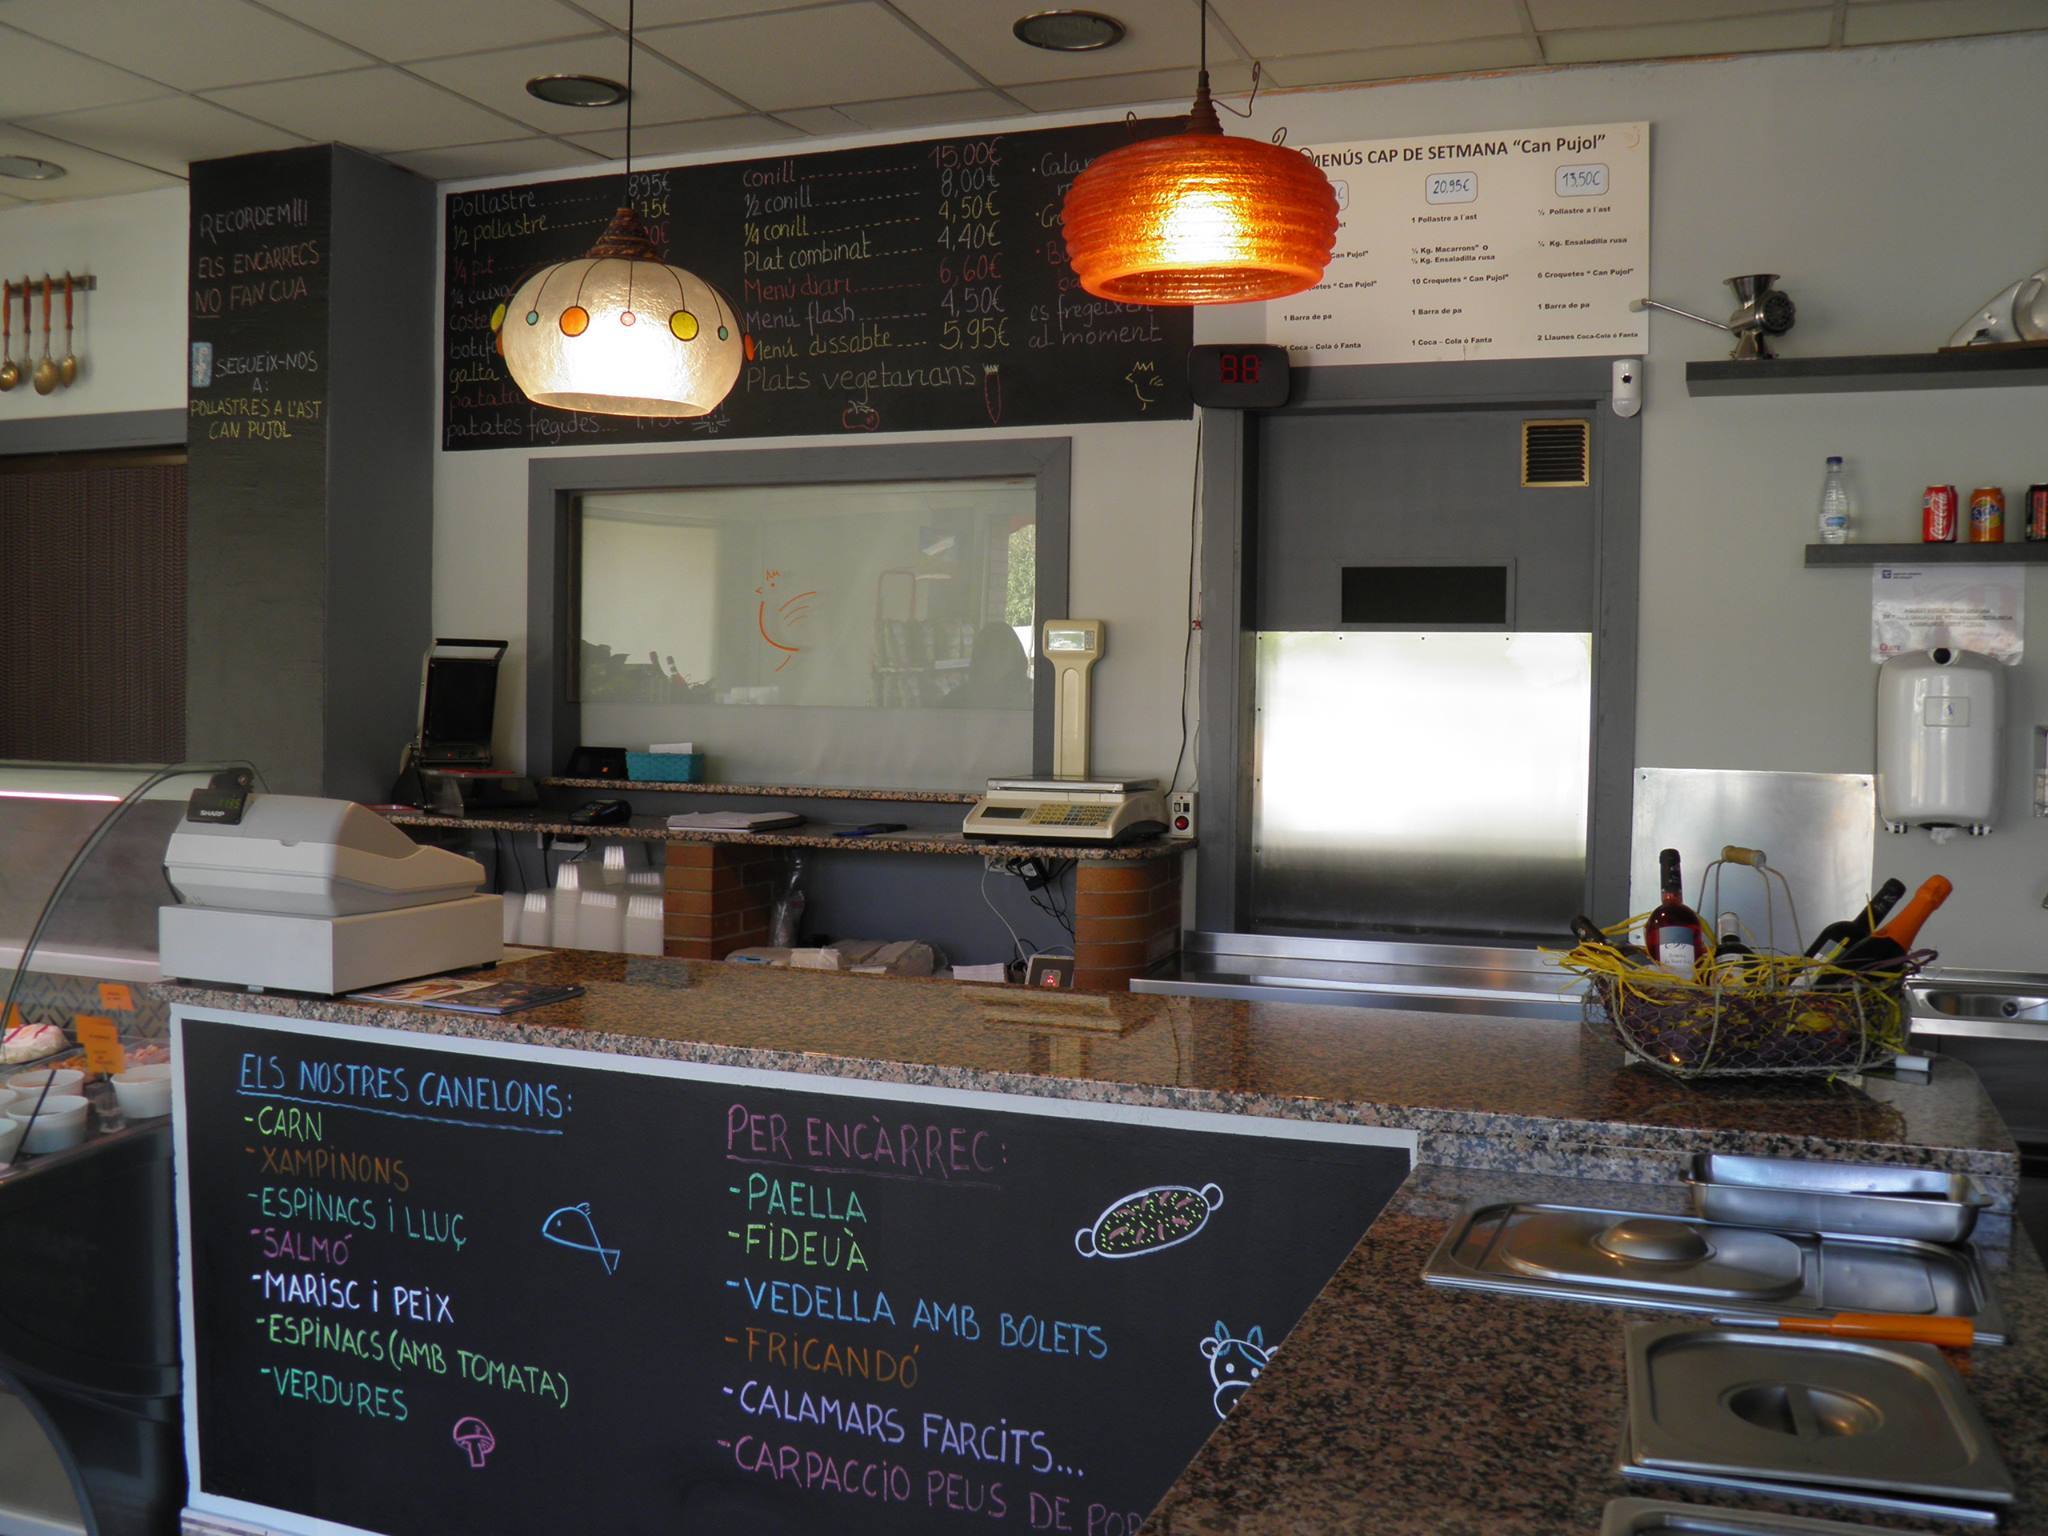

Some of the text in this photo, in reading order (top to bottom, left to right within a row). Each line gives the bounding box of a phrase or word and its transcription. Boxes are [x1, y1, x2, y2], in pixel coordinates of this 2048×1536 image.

[1367, 148, 1399, 165] CAP
[1403, 147, 1423, 162] DE
[1428, 141, 1508, 161] SETMANA
[765, 184, 813, 212] conill
[940, 161, 1001, 198] 8,00€
[200, 198, 308, 244] RECORDEM!!!
[764, 215, 809, 241] conill
[938, 191, 1001, 224] 4,50€
[1418, 215, 1451, 223] Pollastre
[198, 241, 320, 279] ELS ENCÀRRECS
[744, 220, 1001, 274] Plat combinat 4,40€
[1435, 254, 1476, 263] Ensaladilla
[1565, 238, 1608, 246] Ensaladilla
[744, 279, 796, 303] Menú
[801, 274, 851, 296] diari
[1423, 276, 1461, 286] Croquetes
[1545, 271, 1584, 279] Croquetes
[196, 276, 308, 313] NO FAN CUA
[746, 284, 1005, 336] Menú flash 4,50€
[1452, 307, 1462, 315] pa
[1544, 302, 1566, 310] Barra
[809, 322, 893, 357] dissabte
[940, 317, 1010, 350] 5,95€
[1028, 314, 1162, 348] al moment
[1340, 341, 1361, 349] Fanta
[1444, 337, 1462, 345] Cola
[1470, 336, 1493, 344] Fanta
[745, 360, 977, 402] Plats vegetarians
[191, 399, 268, 417] POLLASTRES
[274, 401, 282, 416] A
[209, 421, 292, 441] CAN PUJOL
[447, 411, 523, 447] patates
[240, 1053, 573, 1119] ELS NOSTRES CANELONS:
[726, 1103, 1008, 1180] PER ENCÀRREC:
[404, 1206, 468, 1251] LLUÇ
[912, 1297, 981, 1341] AMB
[999, 1312, 1108, 1360] BOLETS
[457, 1349, 569, 1409] TOMATA)
[927, 1470, 1008, 1519] PEUS
[1029, 1491, 1072, 1531] DE
